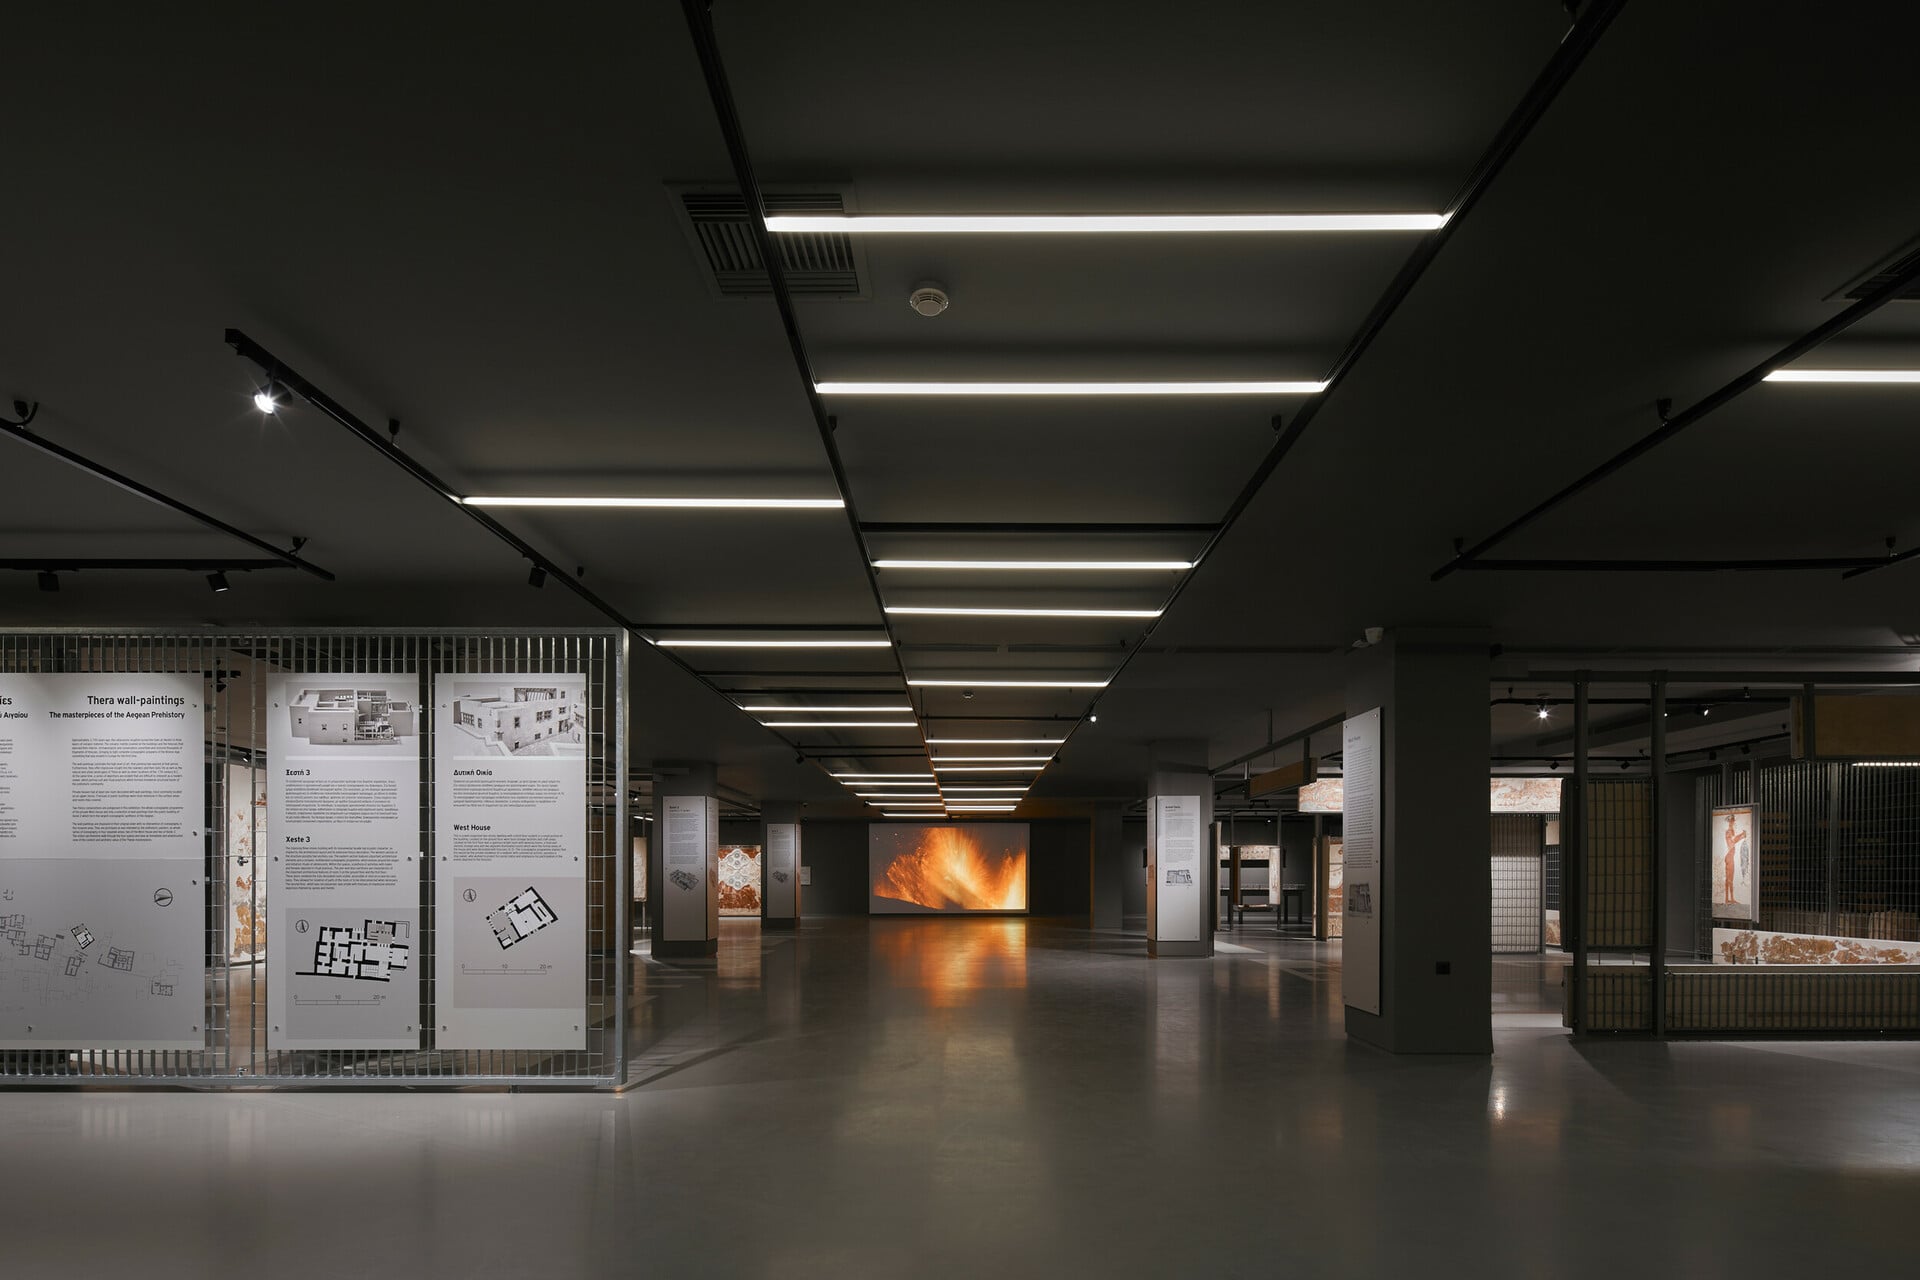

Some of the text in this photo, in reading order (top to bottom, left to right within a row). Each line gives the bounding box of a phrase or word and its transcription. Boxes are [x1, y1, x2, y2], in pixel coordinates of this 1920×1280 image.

[87, 696, 184, 706] Thera wall-paintings
[3, 711, 28, 720] Αιγαίου
[62, 712, 104, 720] masterpieces
[126, 712, 150, 720] Aegean
[151, 712, 185, 720] Prehistory
